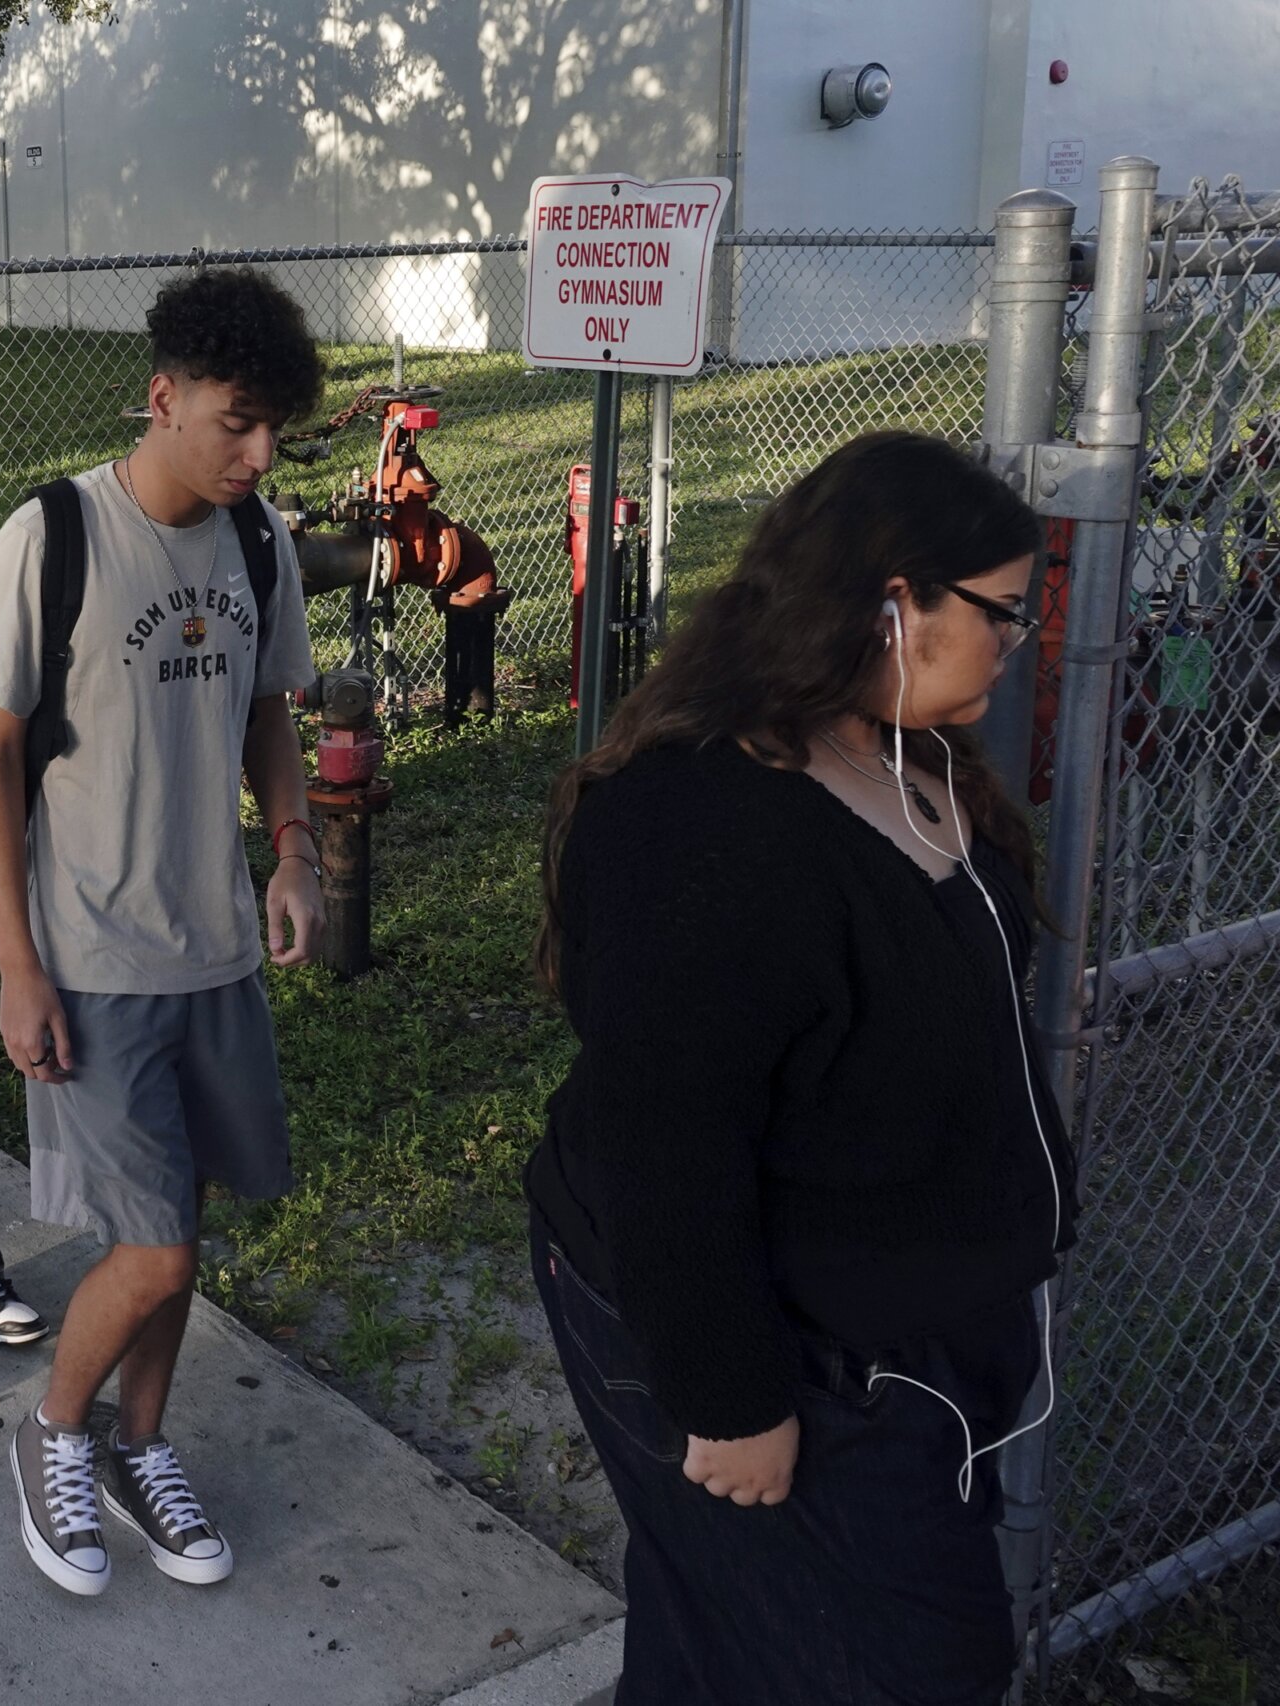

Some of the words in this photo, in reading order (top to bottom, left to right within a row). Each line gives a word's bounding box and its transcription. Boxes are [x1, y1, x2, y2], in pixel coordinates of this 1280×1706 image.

[537, 206, 573, 231] FIRE
[577, 203, 709, 230] DEPARTMENT
[556, 242, 670, 268] CONNECTION
[558, 279, 663, 306] GYMNASIUM
[584, 316, 630, 343] ONLY
[126, 602, 166, 651] SOM
[168, 587, 198, 612] UN
[159, 653, 228, 683] BARÇA
